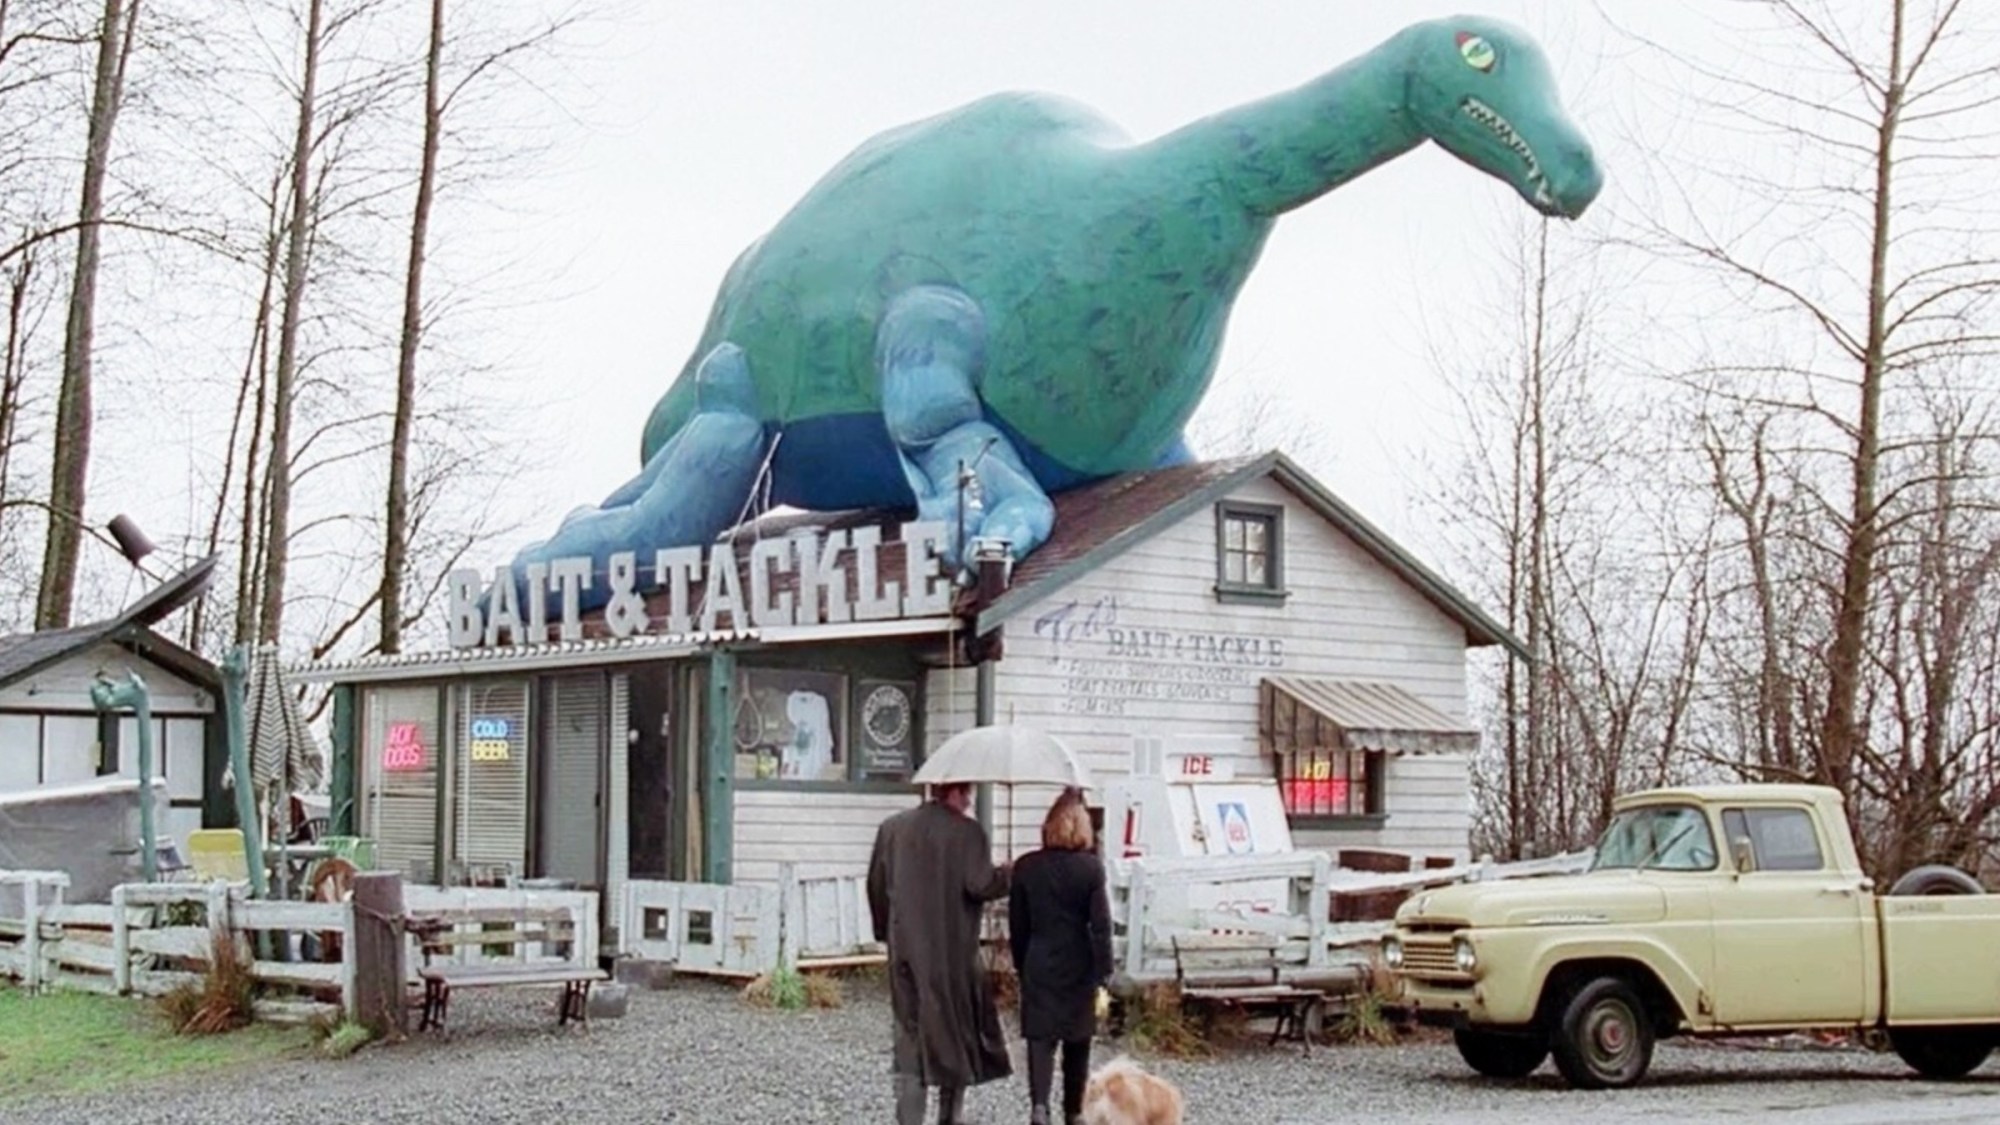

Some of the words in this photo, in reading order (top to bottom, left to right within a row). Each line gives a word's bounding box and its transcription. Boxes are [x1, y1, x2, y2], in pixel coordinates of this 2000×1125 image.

[448, 556, 594, 648] BAIT
[606, 551, 650, 637] &
[655, 521, 953, 638] TACKLE
[1106, 628, 1173, 660] BAIT
[1187, 634, 1285, 667] TACKLE
[388, 723, 418, 745] HOT
[472, 720, 509, 738] COLD
[384, 744, 422, 766] DOGS
[472, 740, 509, 760] BEER
[1182, 756, 1214, 775] ICE
